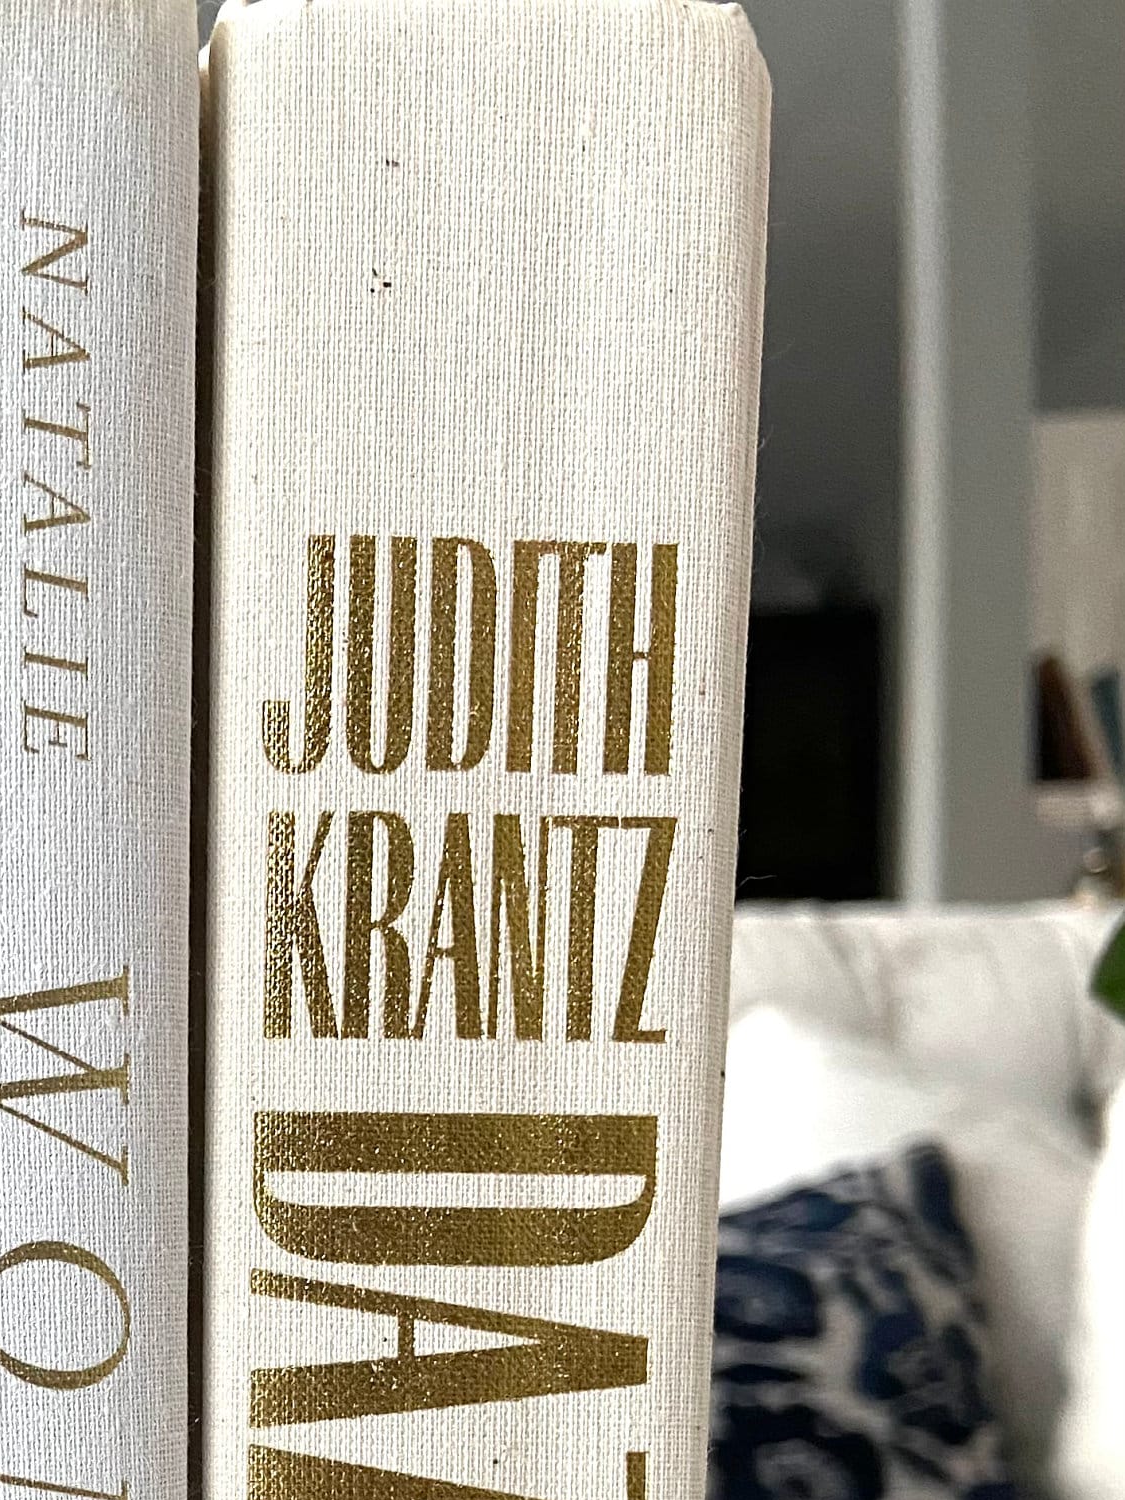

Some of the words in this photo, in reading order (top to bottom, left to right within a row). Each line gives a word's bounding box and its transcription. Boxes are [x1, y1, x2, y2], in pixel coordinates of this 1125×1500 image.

[20, 208, 91, 761] NATALIE
[262, 534, 679, 775] JUDITH
[263, 810, 678, 1043] KRANTZ
